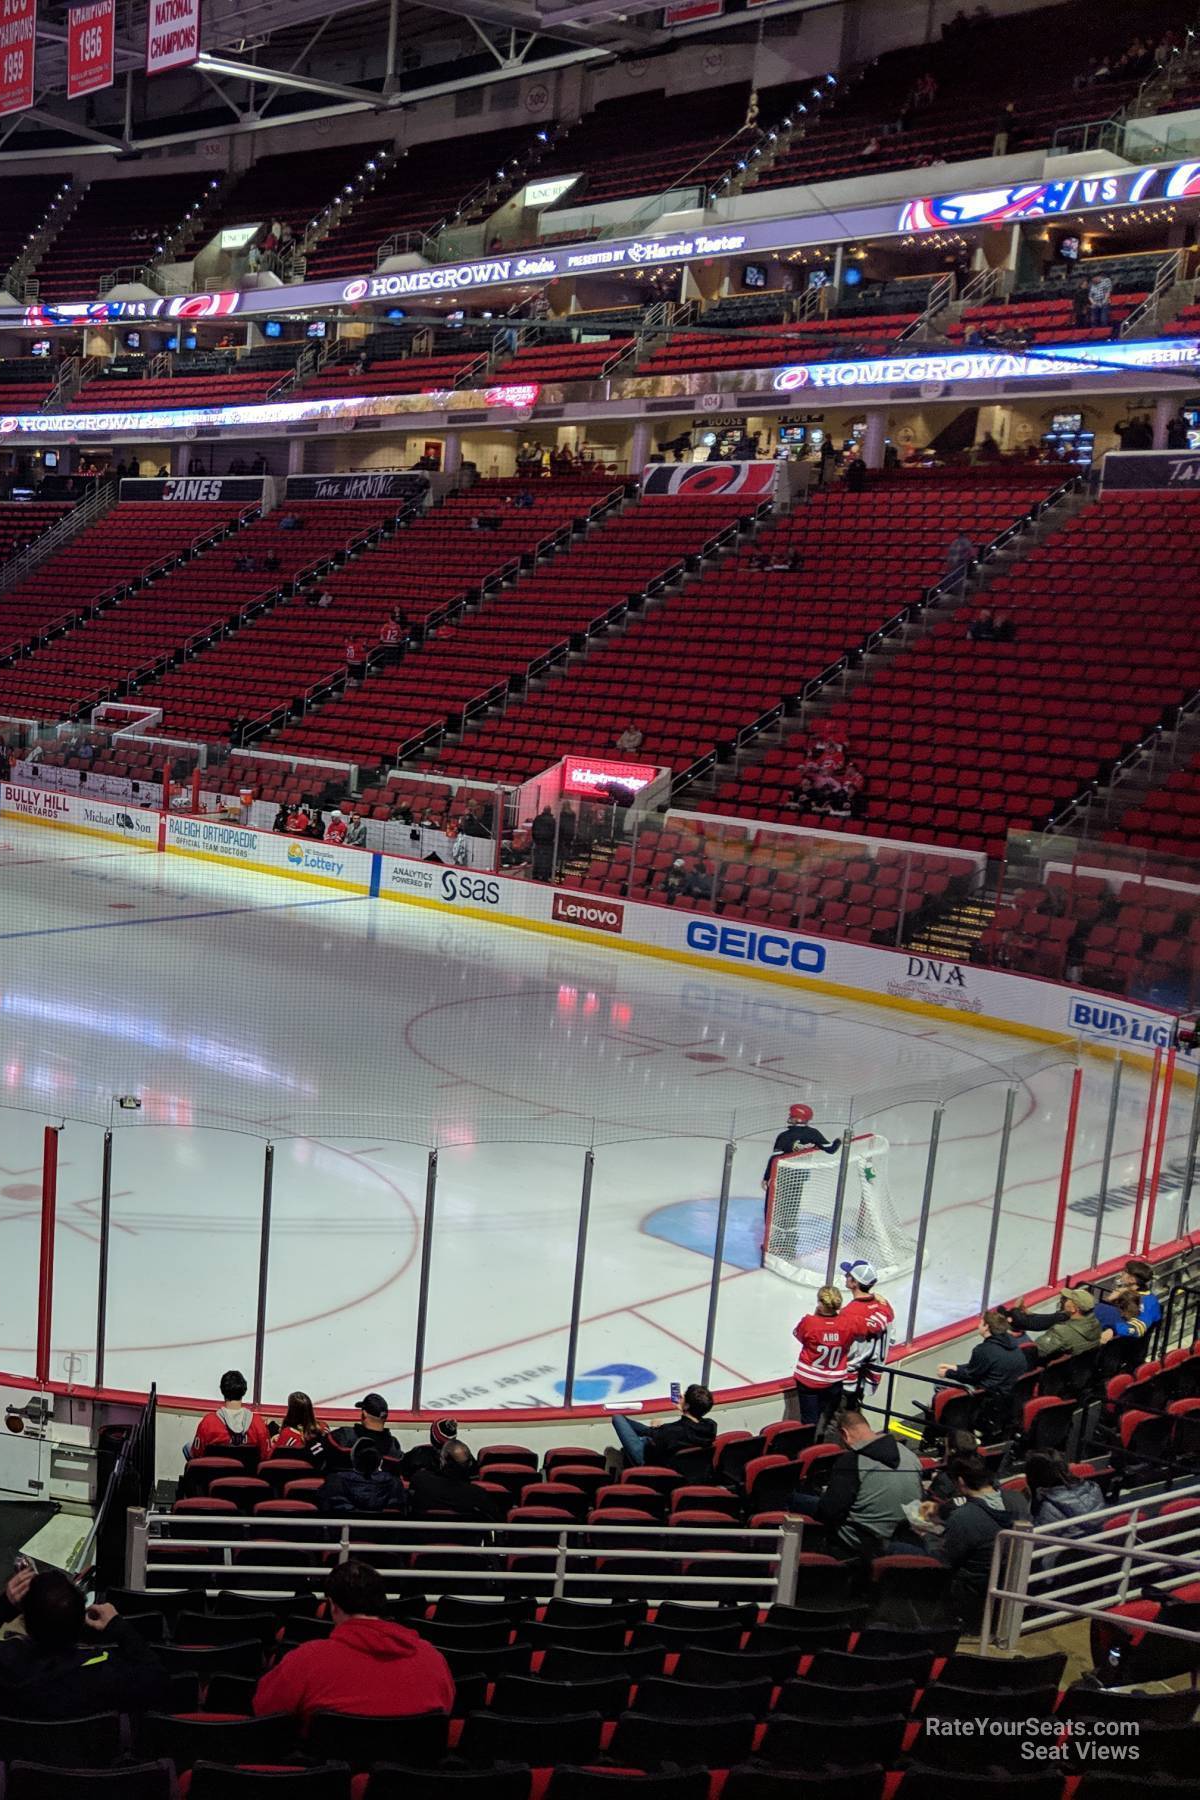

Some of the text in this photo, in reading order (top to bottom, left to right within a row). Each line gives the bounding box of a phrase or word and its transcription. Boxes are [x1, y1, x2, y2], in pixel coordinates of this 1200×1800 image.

[155, 0, 194, 26] NATIONAL
[79, 26, 103, 62] 1956
[150, 25, 196, 60] CHAMPIONS
[3, 51, 25, 84] 1959
[1083, 179, 1118, 203] VS
[568, 249, 625, 267] PRESENTED BY
[646, 240, 693, 260] Harris
[371, 256, 557, 297] HOMEGROWN Series
[127, 303, 146, 316] VS
[815, 355, 1029, 387] HOMEGROWN
[1134, 348, 1200, 366] PRESENTE
[21, 415, 143, 431] HOMEGROWN
[162, 480, 223, 501] CANES
[314, 475, 395, 499] TAKE WARNING
[5, 786, 70, 812] BULLY HILL
[16, 803, 59, 819] VINEYARDS
[84, 808, 151, 833] Michael Son
[169, 818, 258, 850] RALEIGH ORTHOPAEDIC
[176, 837, 248, 858] OFFICIAL TEAM DOCTORS
[304, 854, 344, 876] Lottery
[393, 867, 433, 881] ANALYTICS
[391, 875, 433, 889] POWERED BY
[557, 899, 618, 927] Lenovo
[686, 919, 826, 974] GEICO
[906, 956, 968, 987] DNA
[1074, 1003, 1129, 1036] BUD
[822, 1332, 840, 1342] AHO
[812, 1345, 843, 1370] 20
